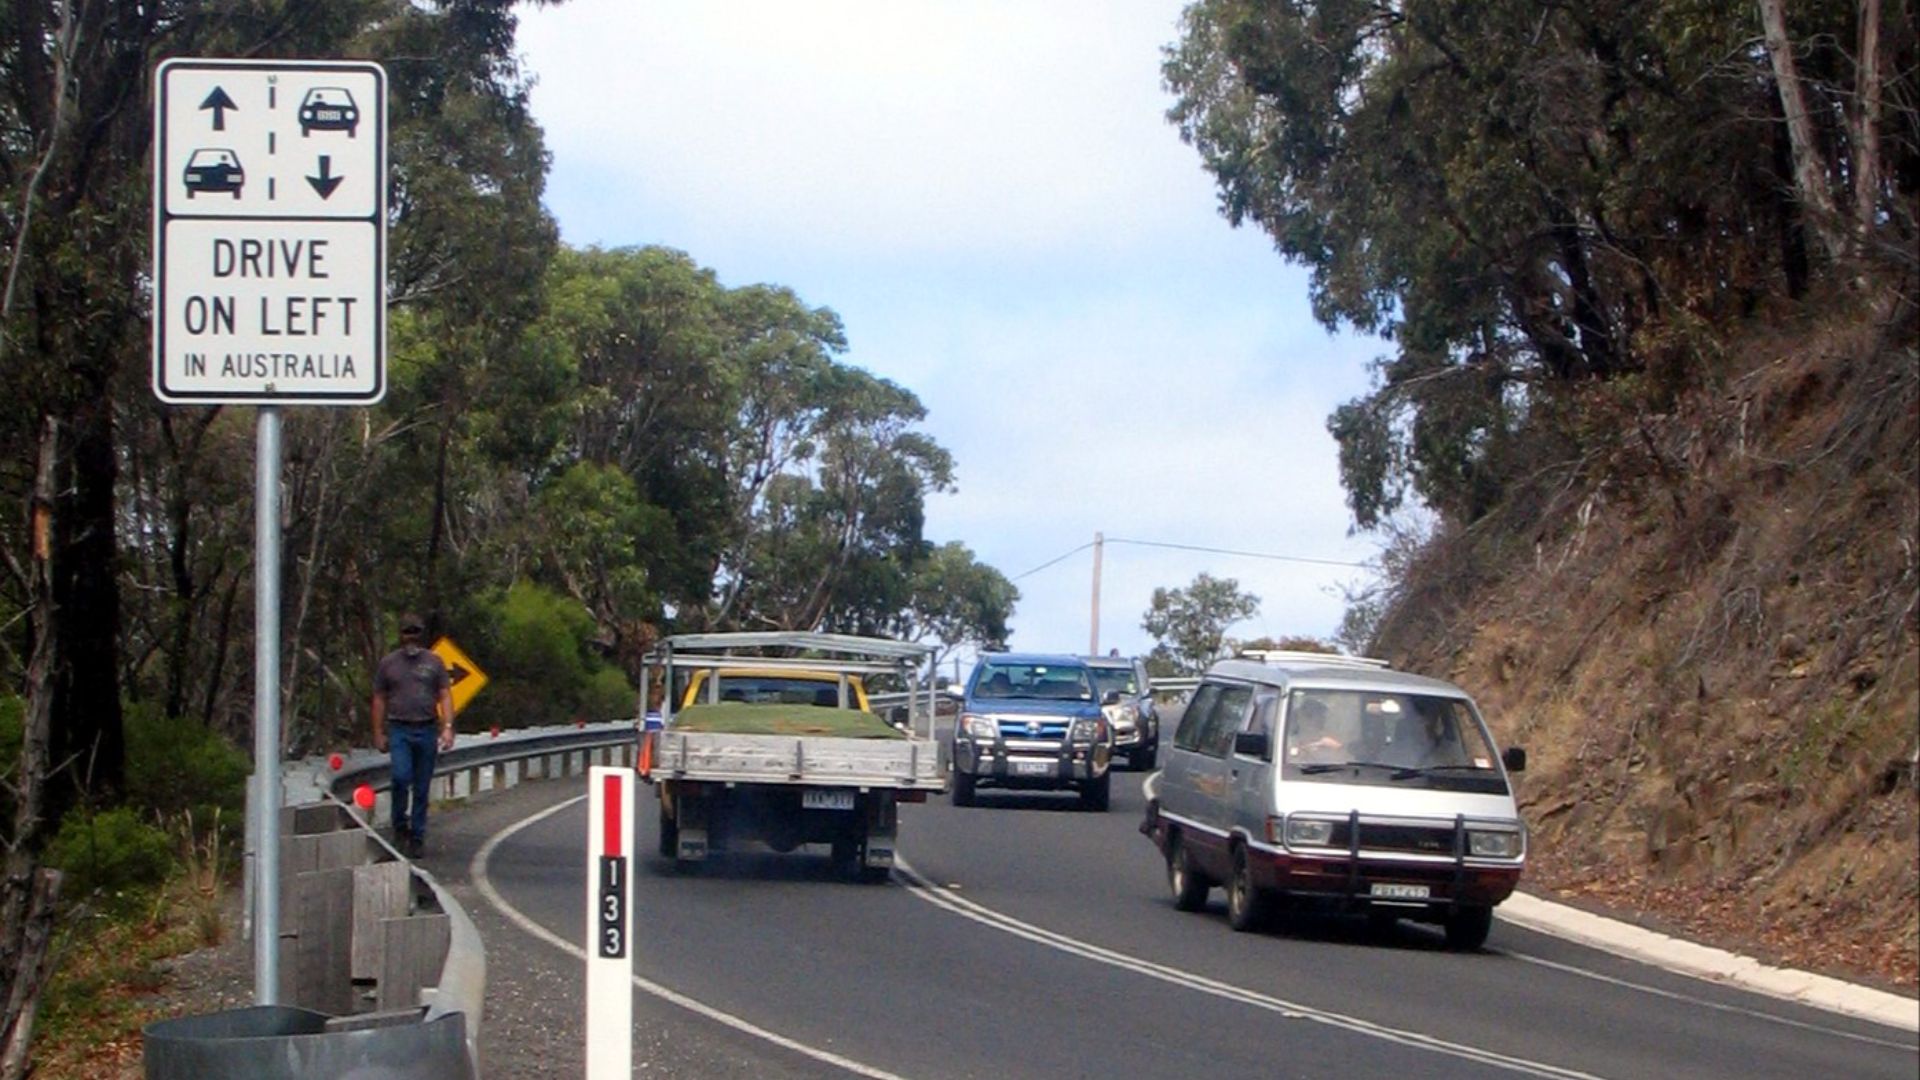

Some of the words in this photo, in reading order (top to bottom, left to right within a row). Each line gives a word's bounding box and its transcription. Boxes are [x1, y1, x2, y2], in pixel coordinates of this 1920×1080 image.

[213, 239, 329, 278] DRIVE
[184, 295, 235, 335] ON
[260, 296, 358, 336] LEFT
[184, 353, 205, 377] IN
[221, 353, 357, 378] AUSTRALIA
[604, 860, 620, 955] 133
